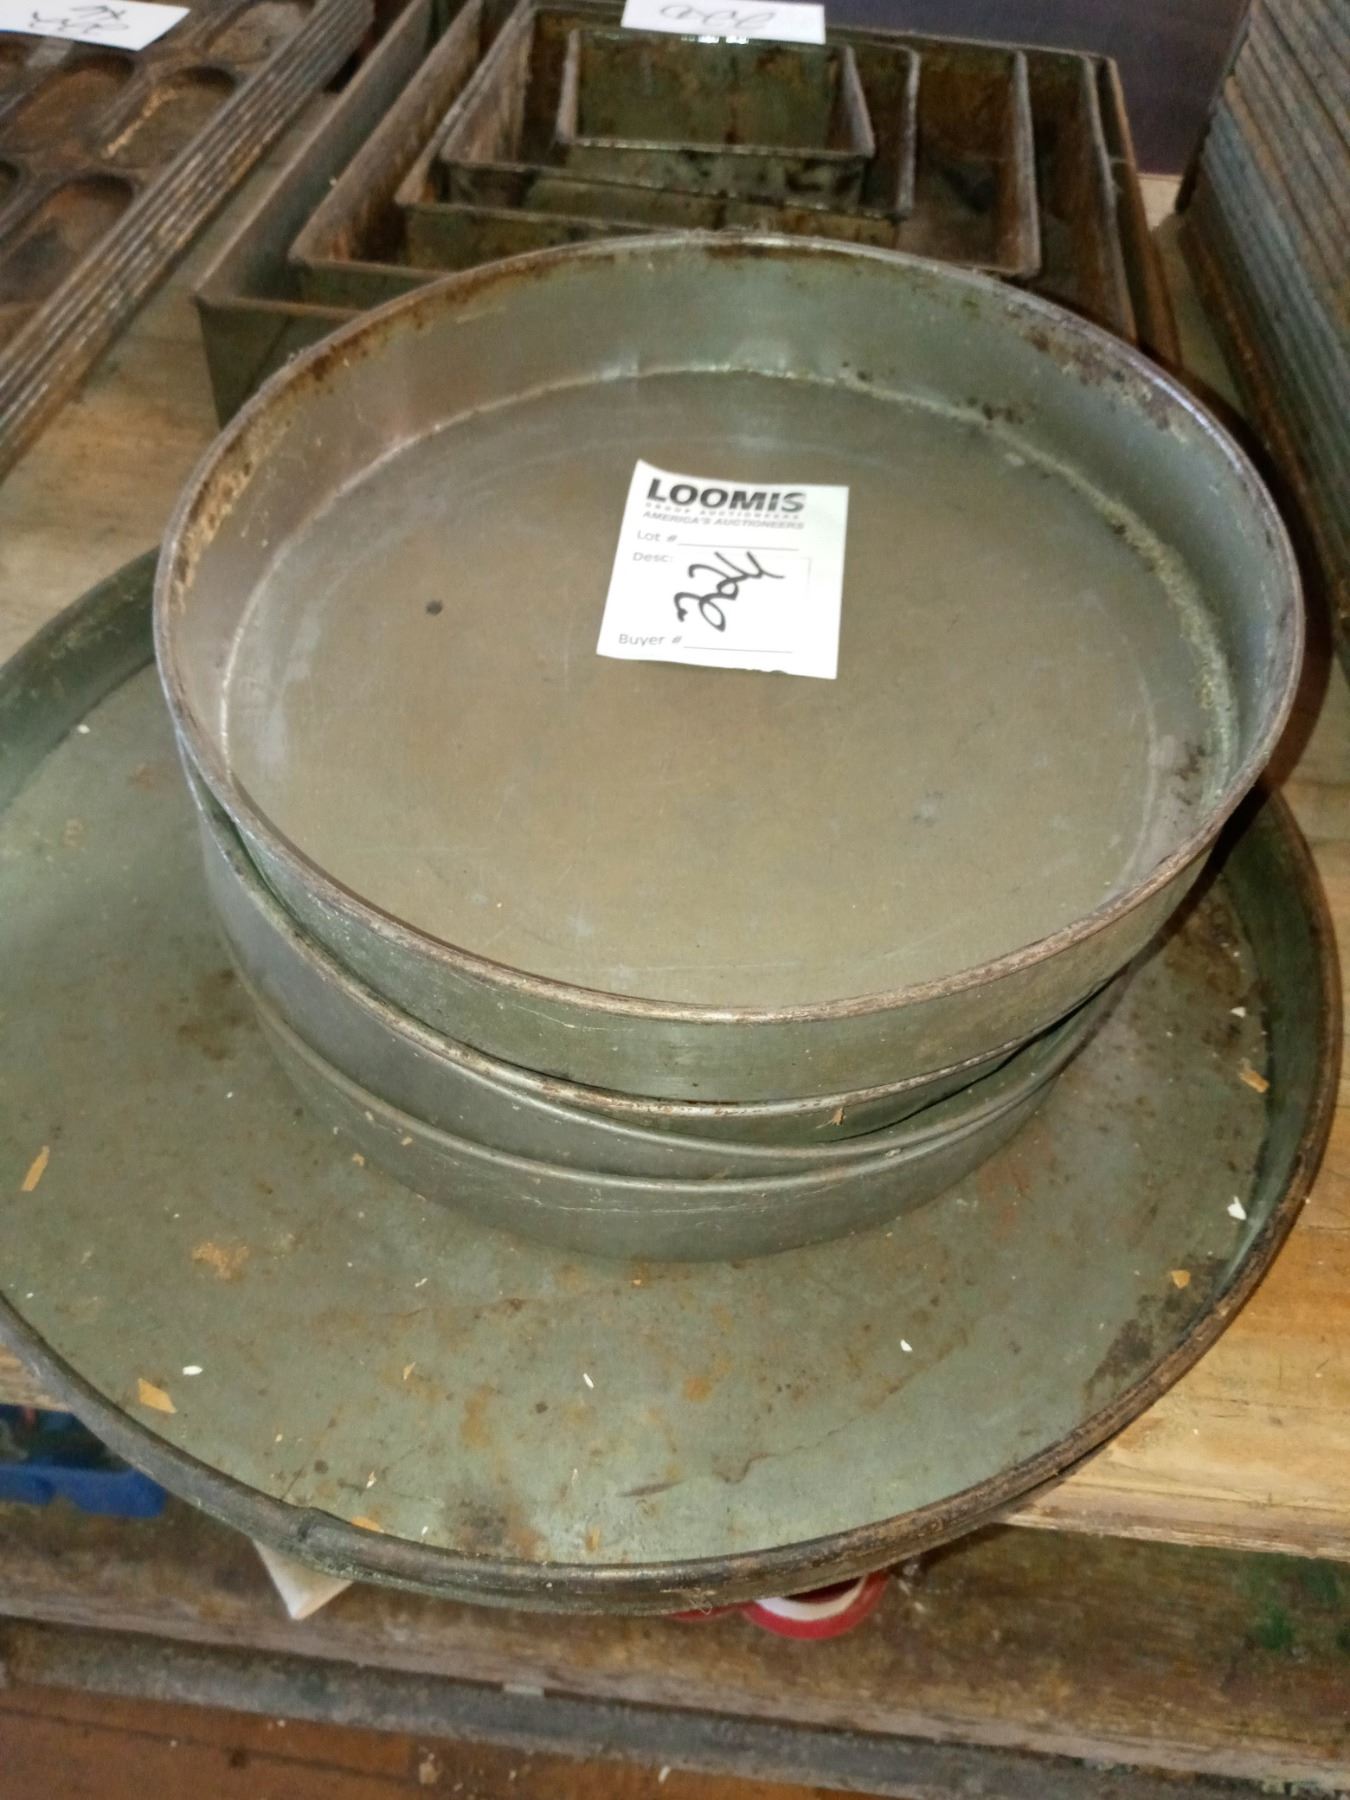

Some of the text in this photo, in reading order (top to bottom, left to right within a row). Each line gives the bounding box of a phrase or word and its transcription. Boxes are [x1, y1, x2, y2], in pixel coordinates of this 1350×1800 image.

[646, 477, 806, 513] LOOMIS
[643, 510, 804, 529] AMERICA'S AUCTIONEERS
[637, 530, 677, 543] Lot #
[632, 551, 674, 563] Desc:
[618, 633, 682, 647] Buyer #
